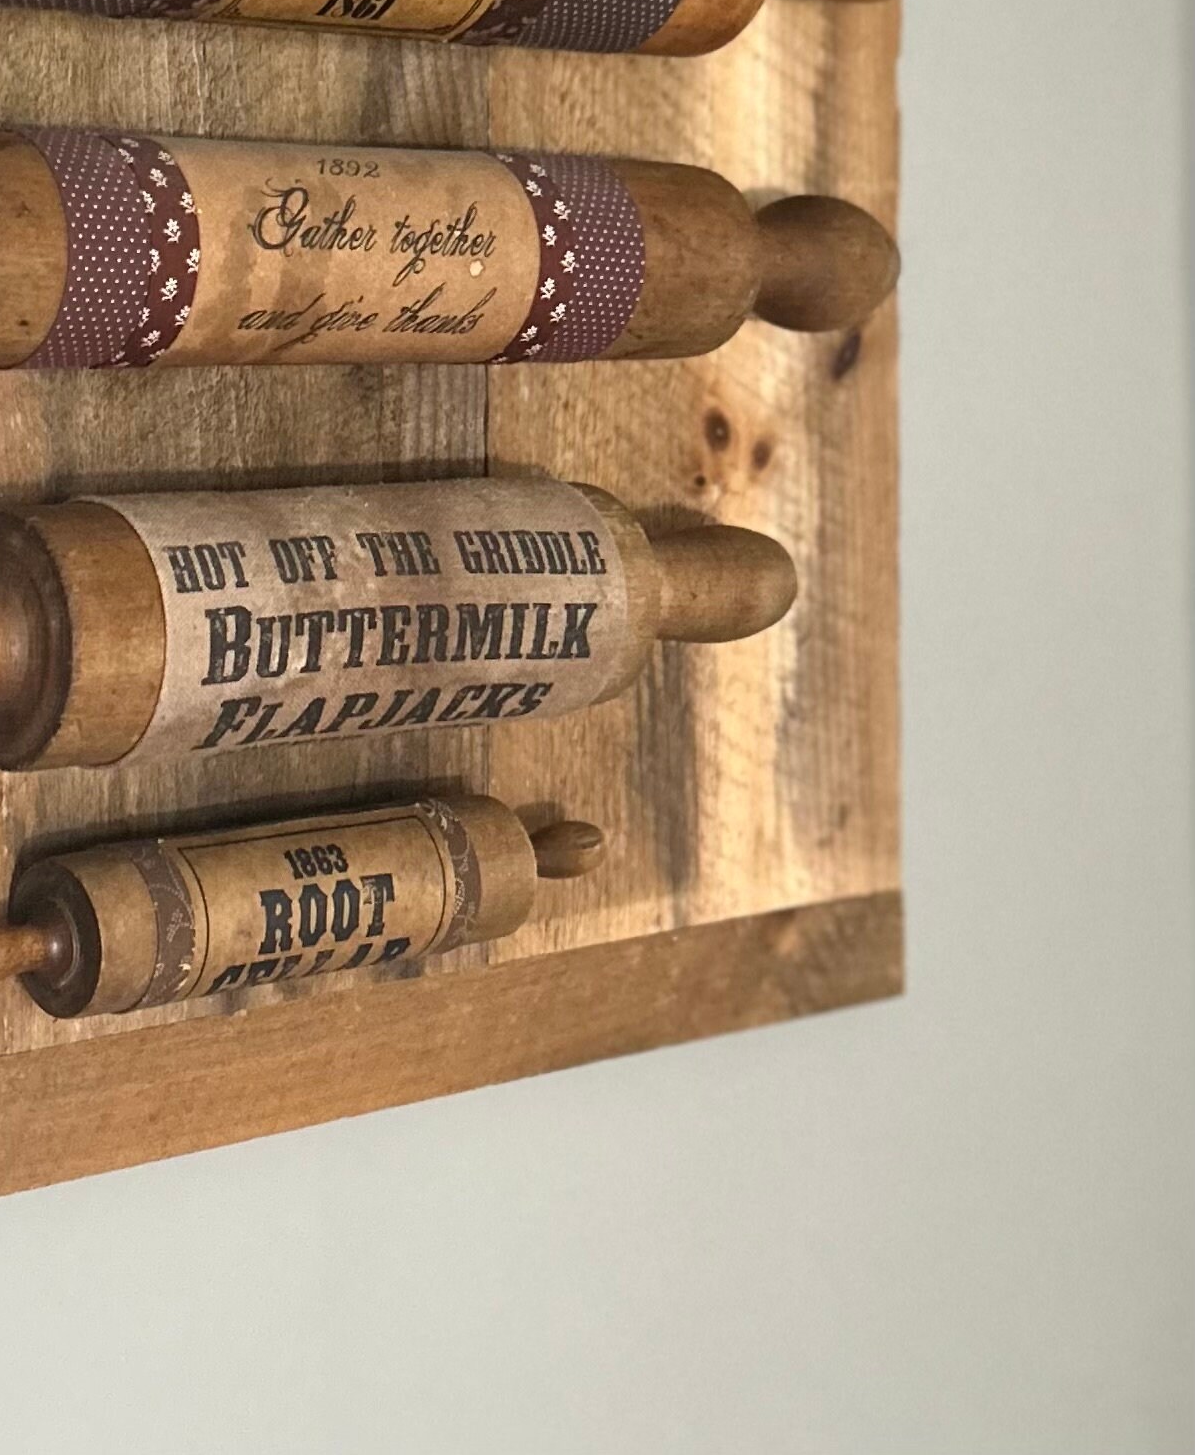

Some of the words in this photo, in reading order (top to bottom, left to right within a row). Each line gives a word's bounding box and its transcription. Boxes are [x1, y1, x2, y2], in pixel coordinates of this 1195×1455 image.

[317, 158, 381, 179] 1892
[247, 178, 378, 257] Gather
[390, 201, 498, 287] together
[237, 292, 326, 331] and
[273, 295, 379, 352] give
[381, 282, 498, 335] thanks
[163, 540, 249, 594] HOT
[269, 534, 339, 585] OFF
[357, 530, 442, 577] THE
[453, 530, 607, 576] GRIDDLE
[201, 602, 599, 686] BUTTERMILK
[192, 681, 554, 750] FLAPJACKS
[258, 873, 395, 955] ROOT
